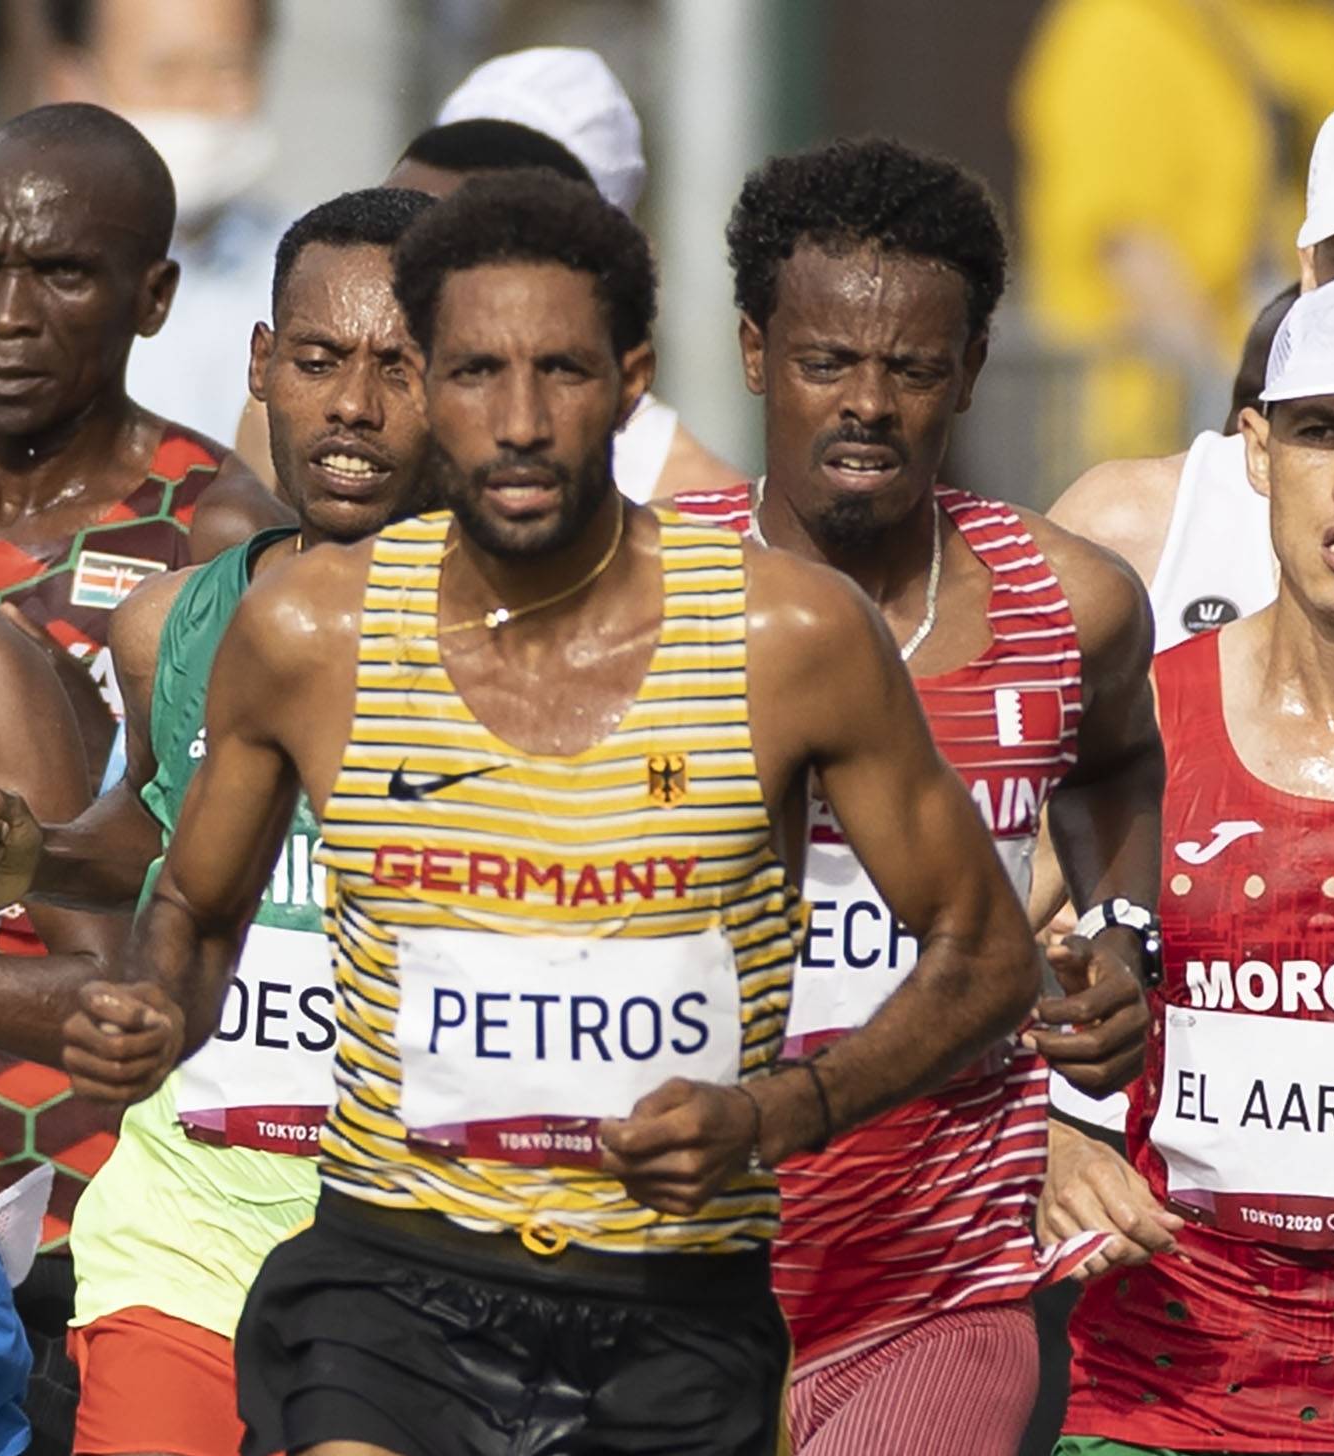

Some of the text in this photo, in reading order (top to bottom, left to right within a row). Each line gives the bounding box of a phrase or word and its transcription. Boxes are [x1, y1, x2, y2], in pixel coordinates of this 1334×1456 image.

[370, 844, 699, 907] GERMANY
[427, 986, 710, 1062] PETROS
[1175, 1070, 1219, 1125] EL
[256, 1120, 307, 1142] TOKYO
[498, 1131, 593, 1153] TOKYO 2020
[1239, 1206, 1323, 1232] TOKYO 2020
